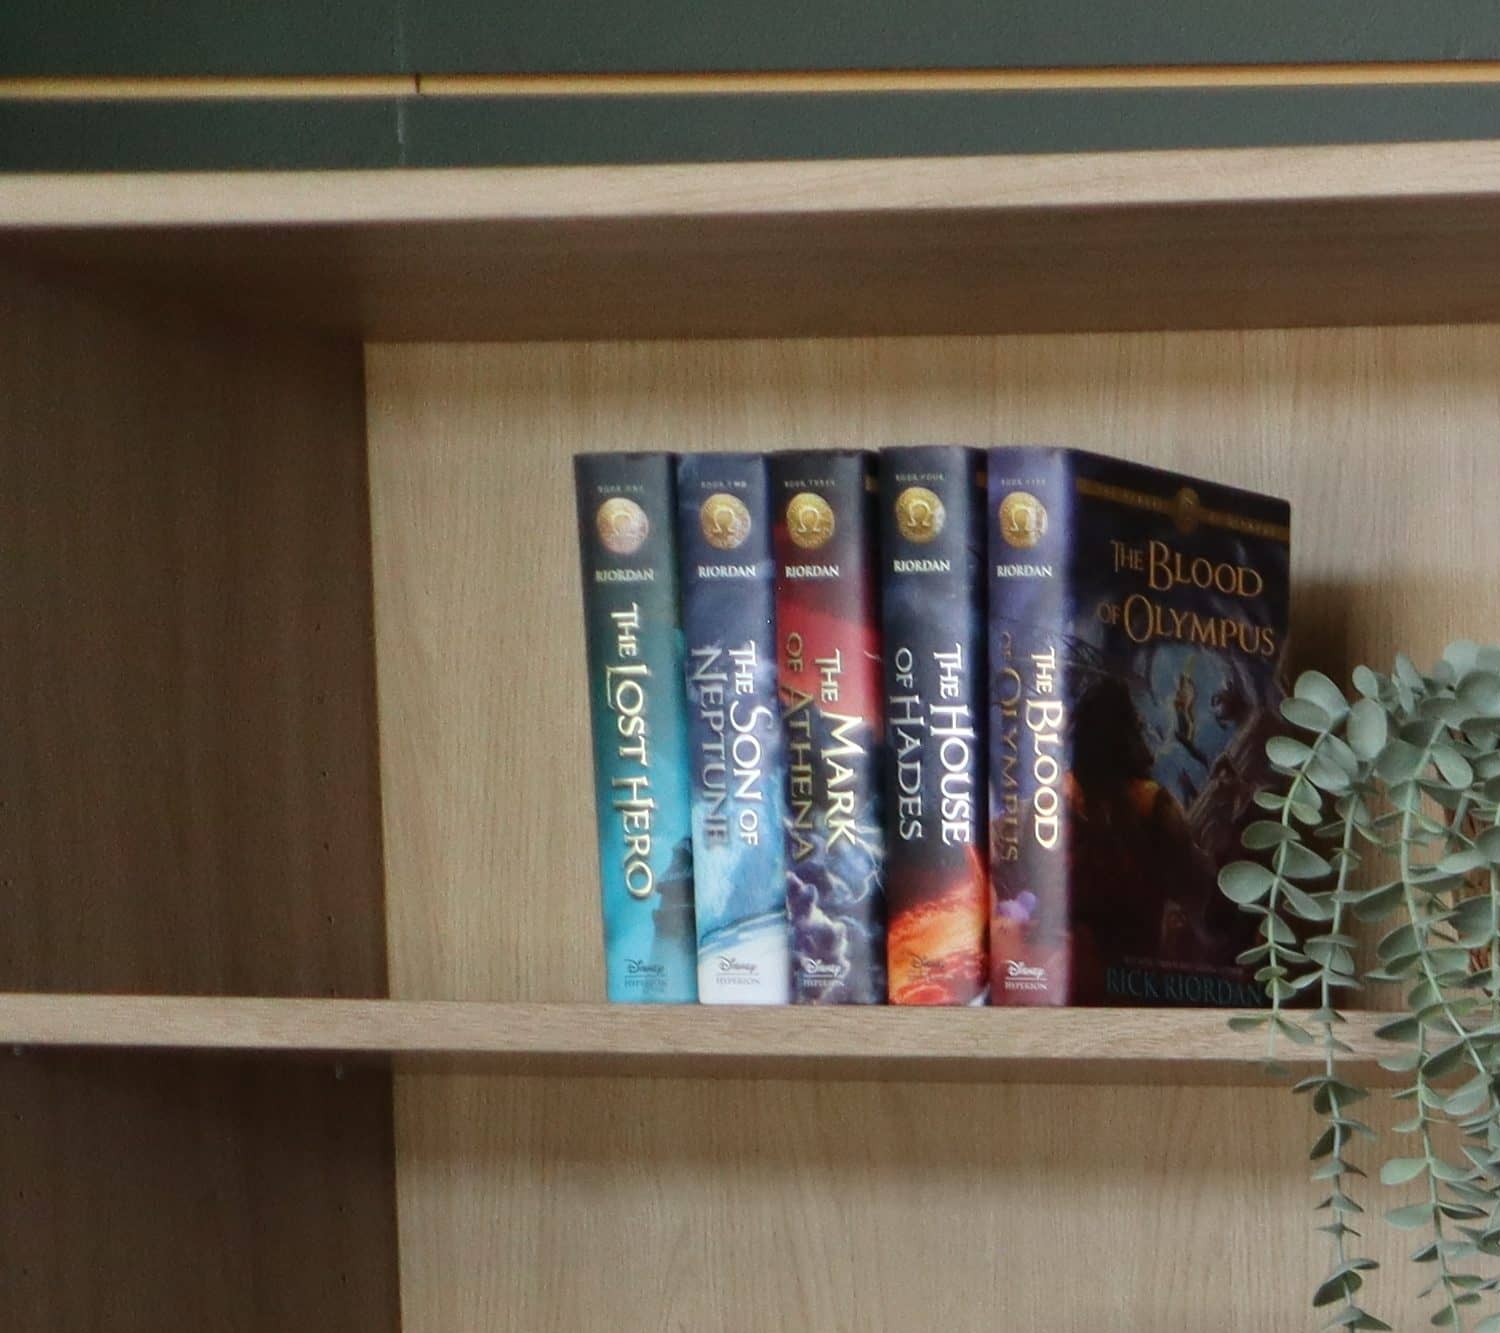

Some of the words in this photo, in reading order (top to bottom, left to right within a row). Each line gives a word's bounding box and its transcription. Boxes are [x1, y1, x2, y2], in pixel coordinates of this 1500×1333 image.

[699, 565, 756, 578] RIORDAN
[1111, 540, 1144, 573] THE
[1148, 540, 1263, 598] BLOOD
[610, 601, 640, 658] THE
[1124, 593, 1275, 657] OLYMPUS
[893, 646, 915, 690] OF
[934, 642, 962, 702] THE
[606, 664, 648, 769] LOST
[890, 696, 922, 841] HADES
[929, 700, 971, 846] HOUSE
[610, 774, 656, 898] HERO
